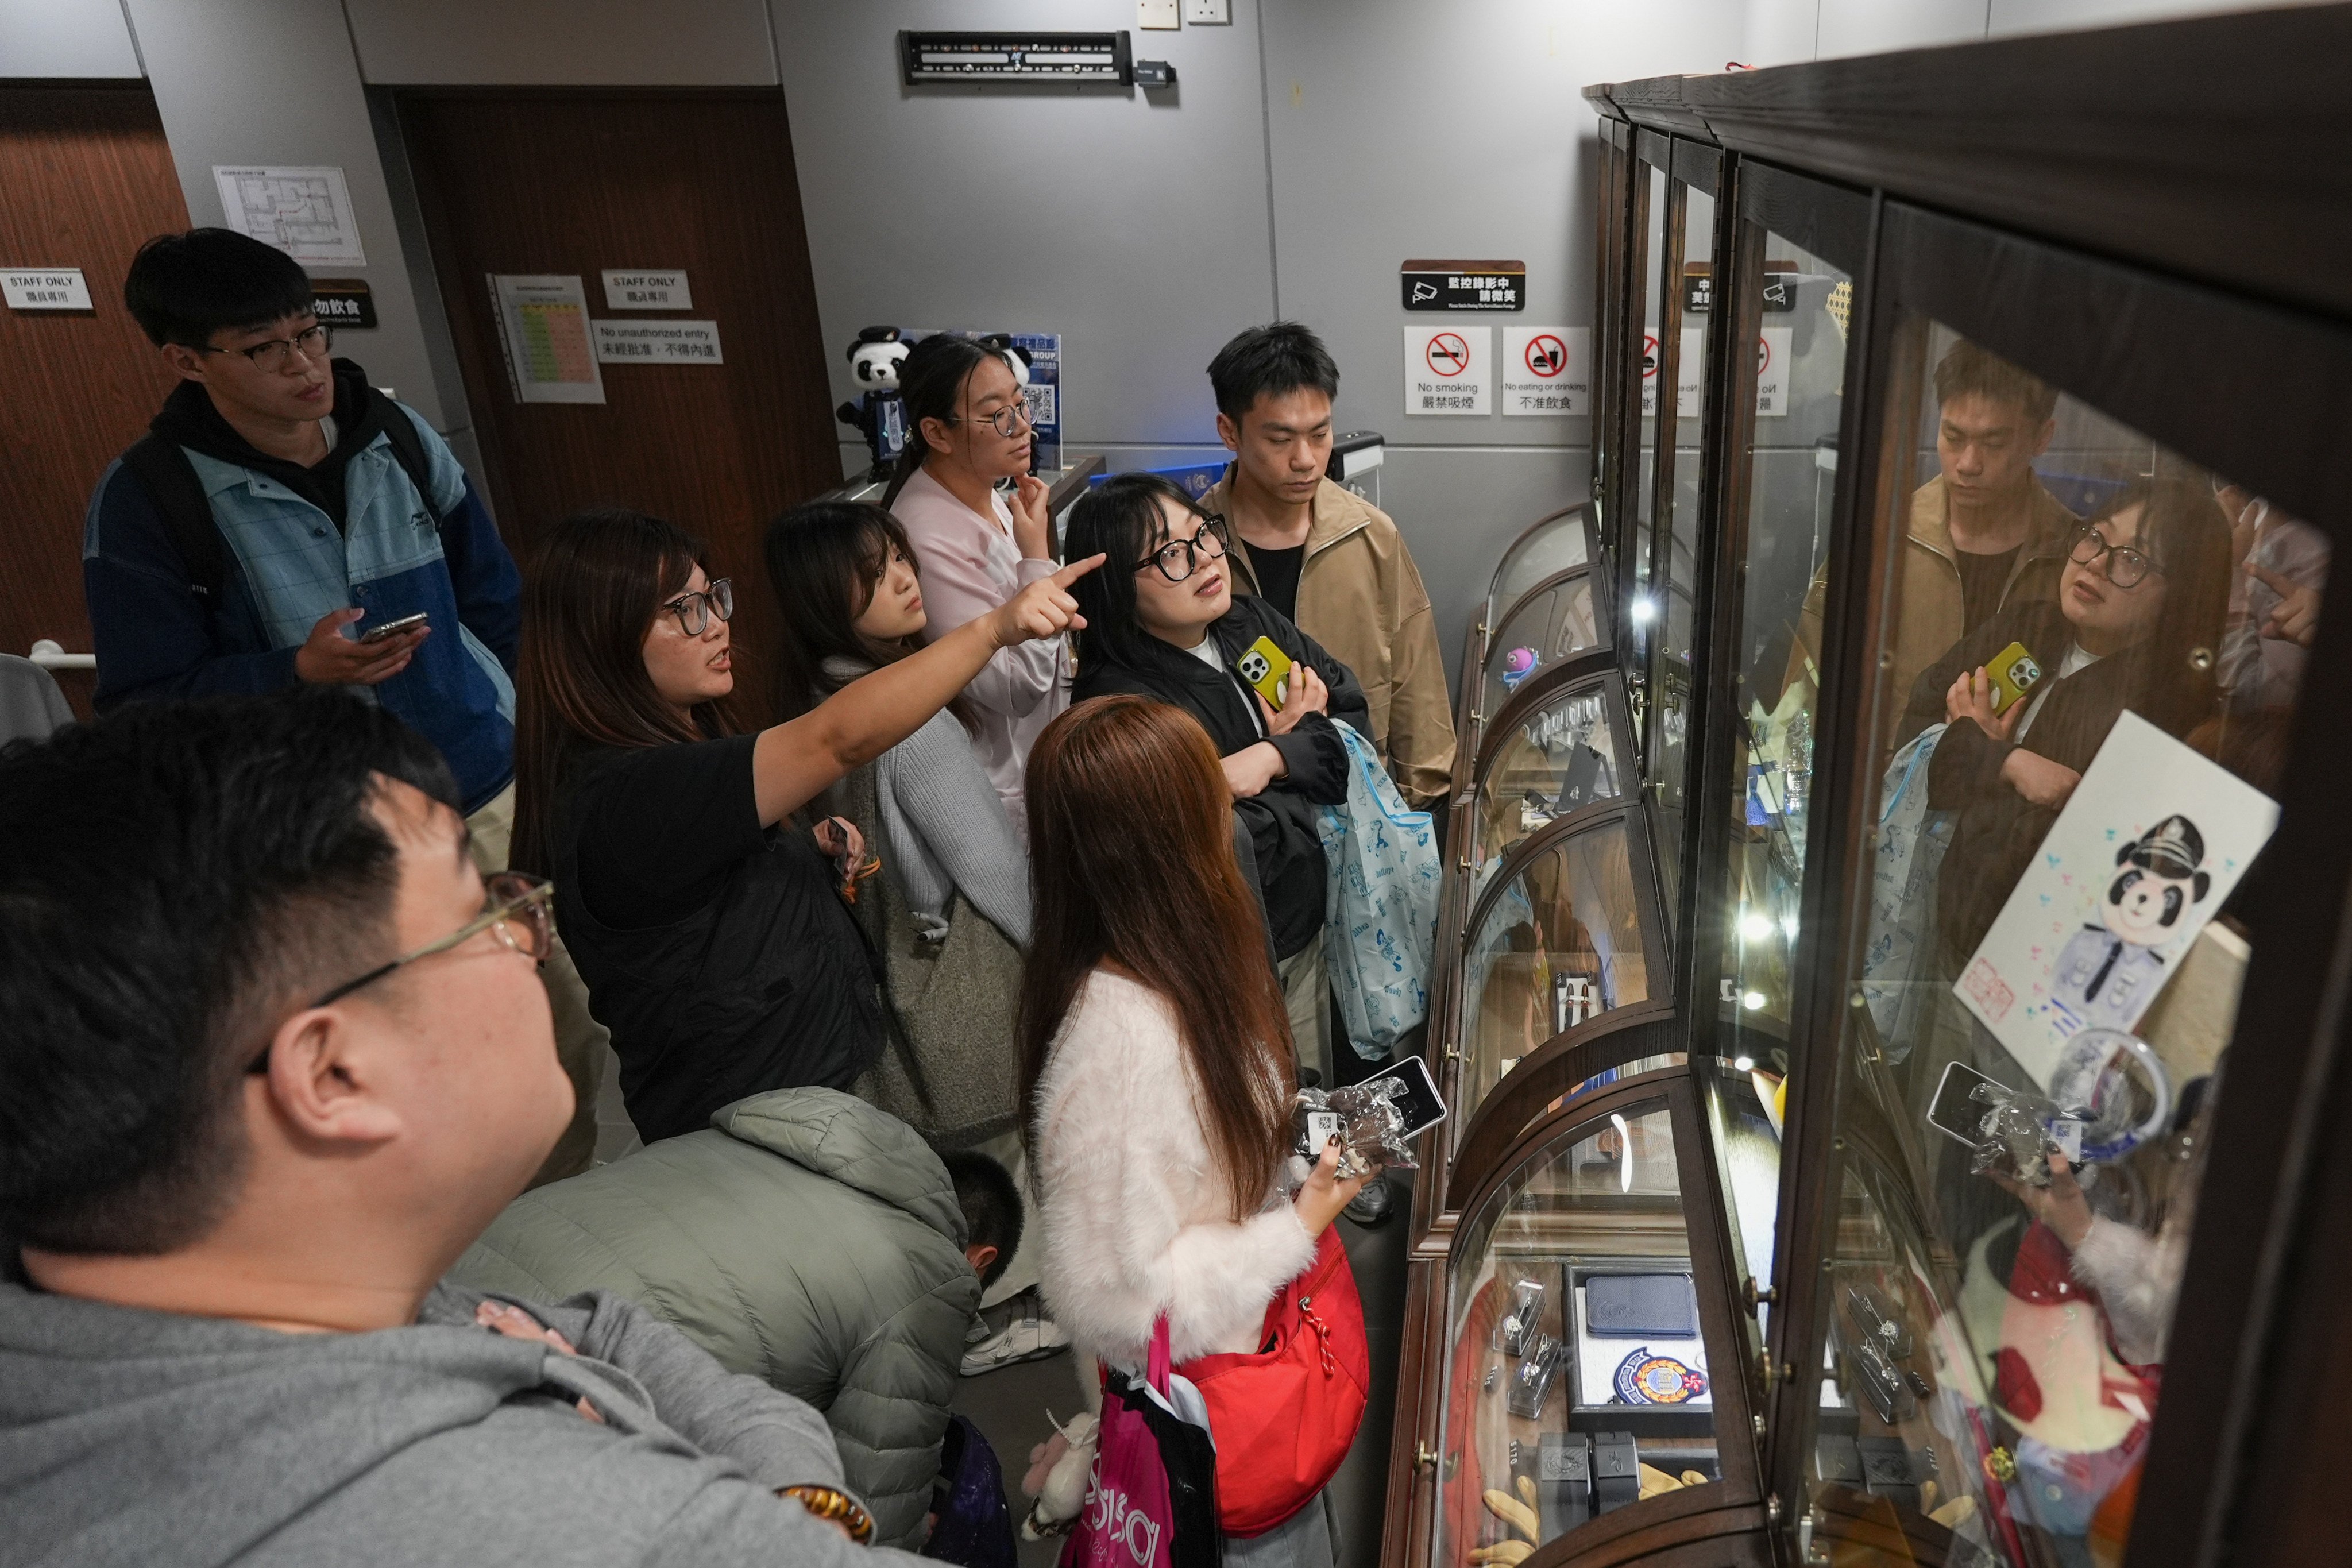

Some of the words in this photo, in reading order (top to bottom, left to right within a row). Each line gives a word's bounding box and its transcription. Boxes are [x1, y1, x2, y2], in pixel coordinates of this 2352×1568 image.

[10, 277, 42, 287] STAFF
[45, 277, 72, 287] ONLY
[613, 277, 644, 286] STAFF
[648, 277, 675, 286] ONLY
[1479, 289, 1516, 302] 請微笑
[311, 299, 360, 315] 勿飲食
[601, 329, 615, 337] No
[618, 328, 682, 338] unauthorized
[685, 330, 709, 341] entry
[1418, 383, 1432, 392] No
[1436, 383, 1478, 395] smoking
[1518, 383, 1543, 392] eating
[1555, 383, 1586, 393] drinking
[1422, 396, 1474, 410] 嚴禁吸煙
[1520, 396, 1571, 410] 不准飲食
